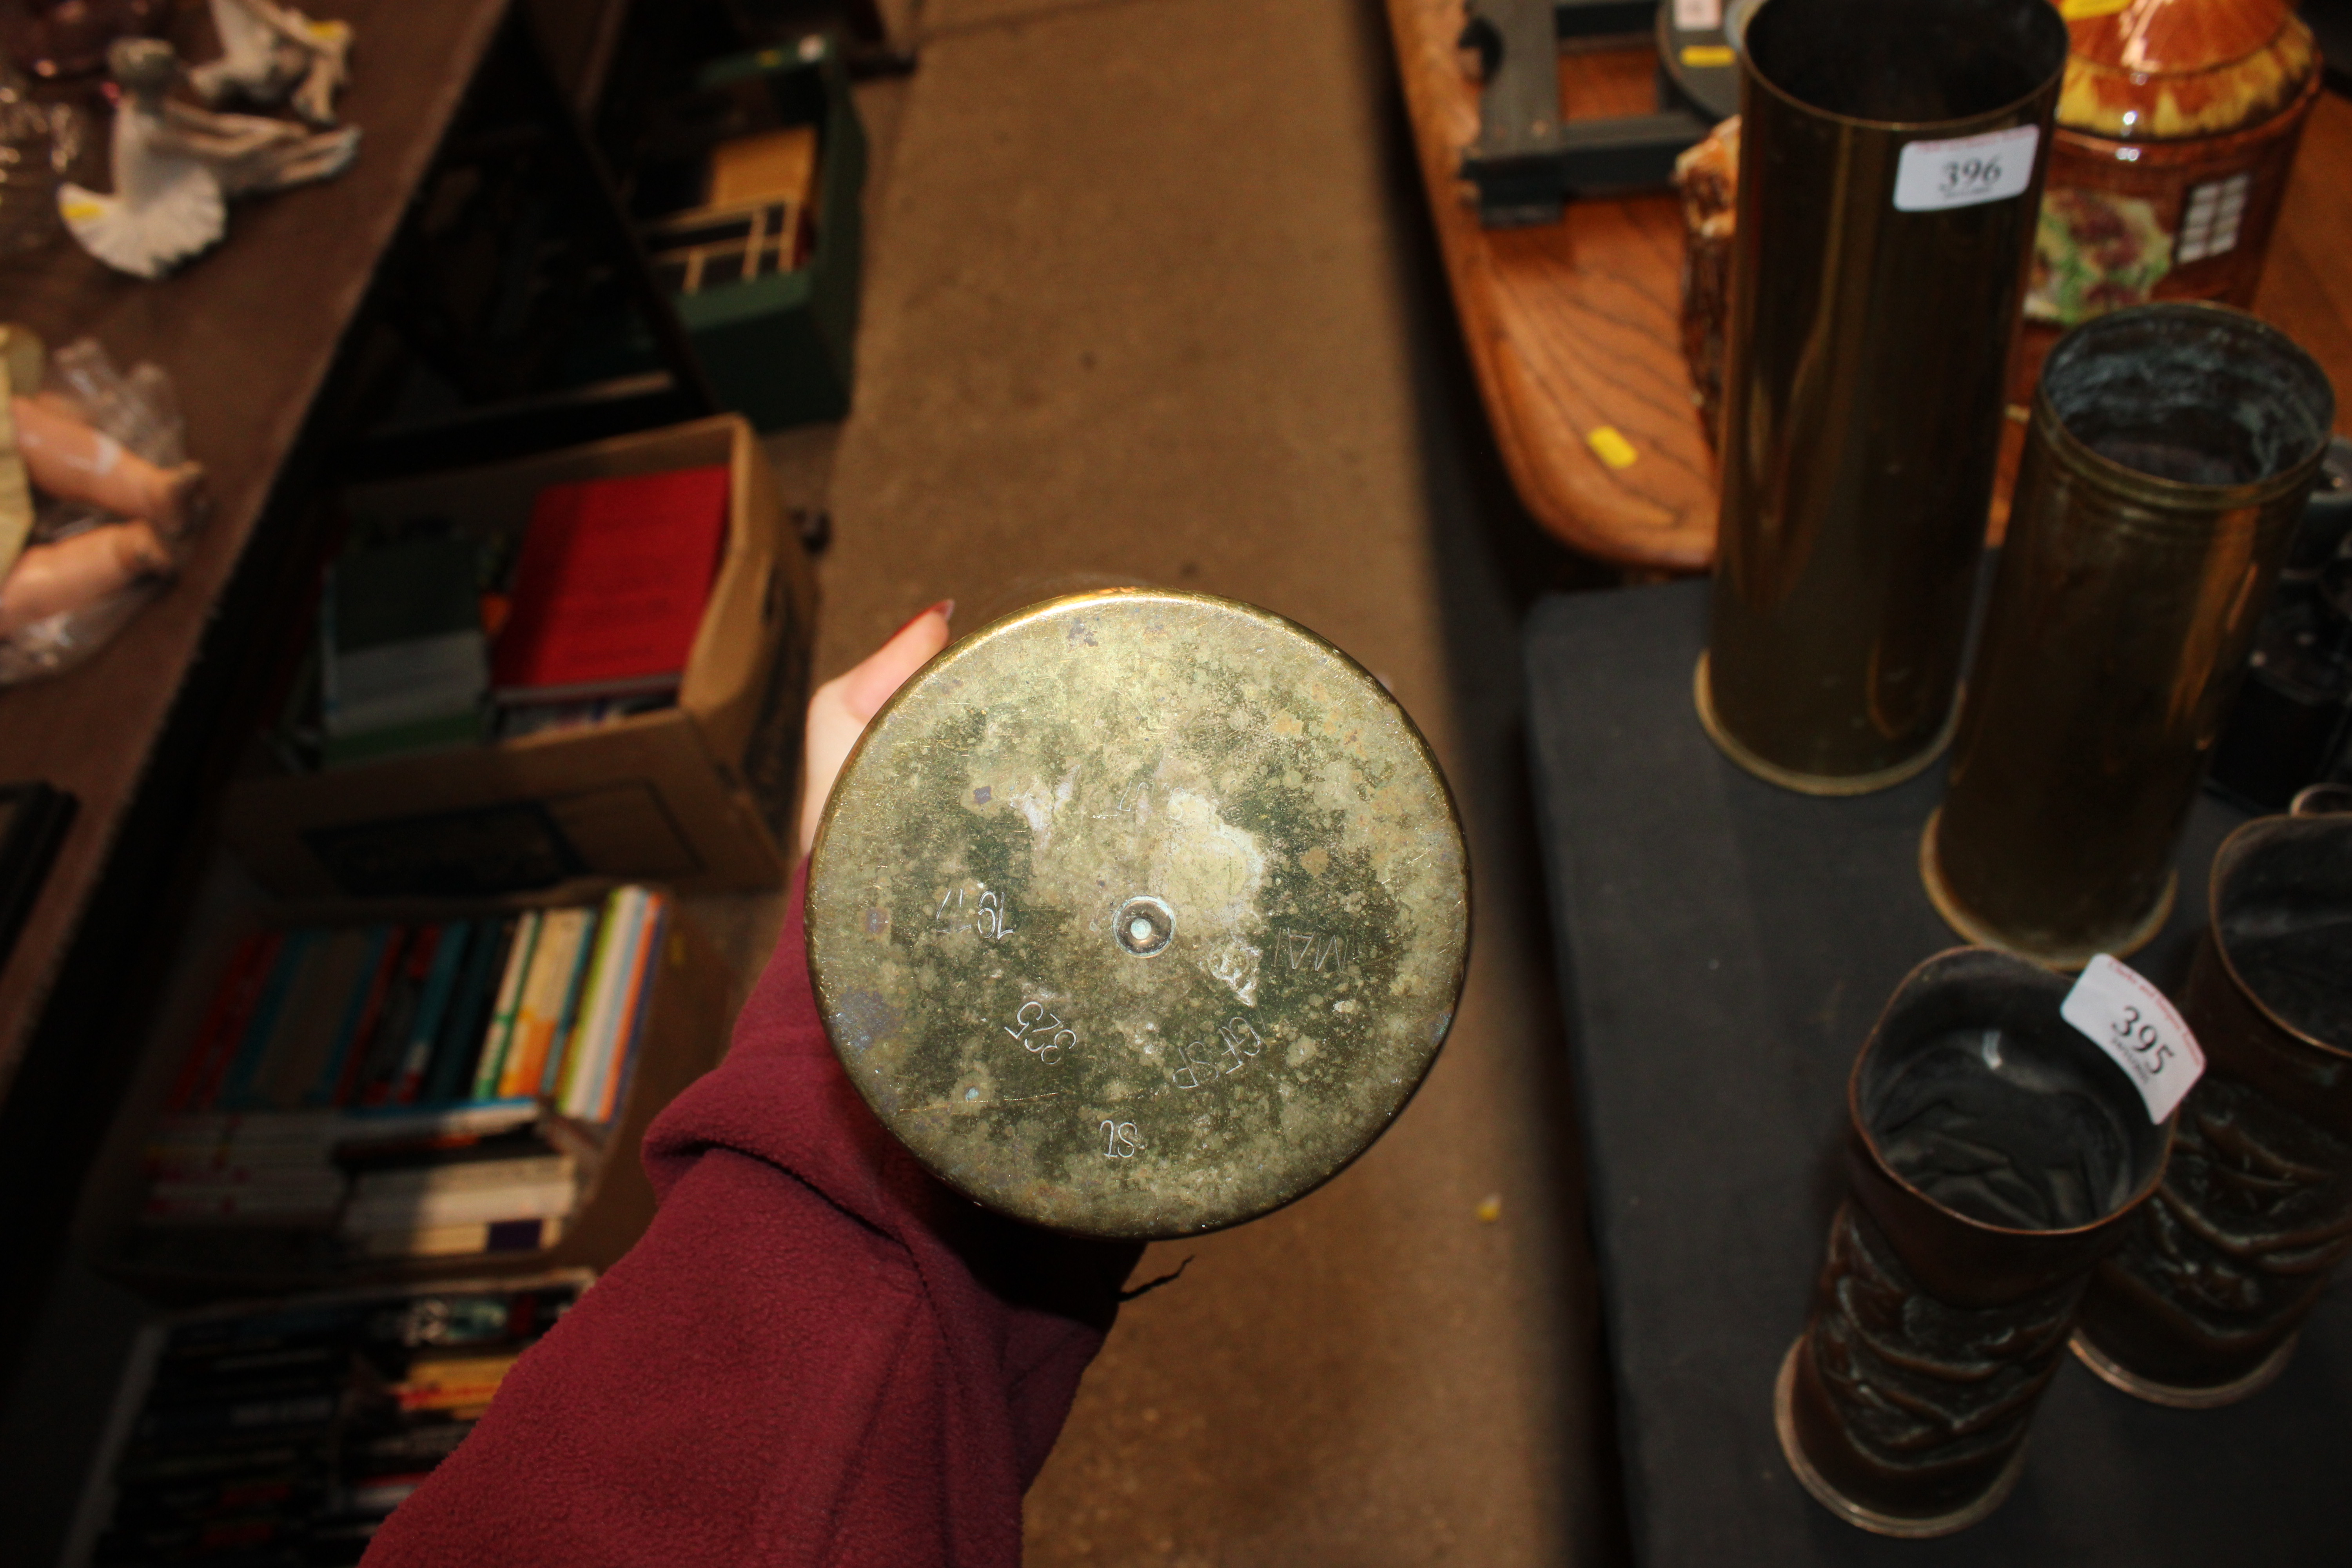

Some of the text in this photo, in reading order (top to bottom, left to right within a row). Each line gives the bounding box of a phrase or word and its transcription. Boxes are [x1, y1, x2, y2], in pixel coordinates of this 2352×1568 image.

[1939, 156, 2001, 190] 396
[1005, 1001, 1076, 1065] 325
[2112, 1006, 2174, 1074] 395
